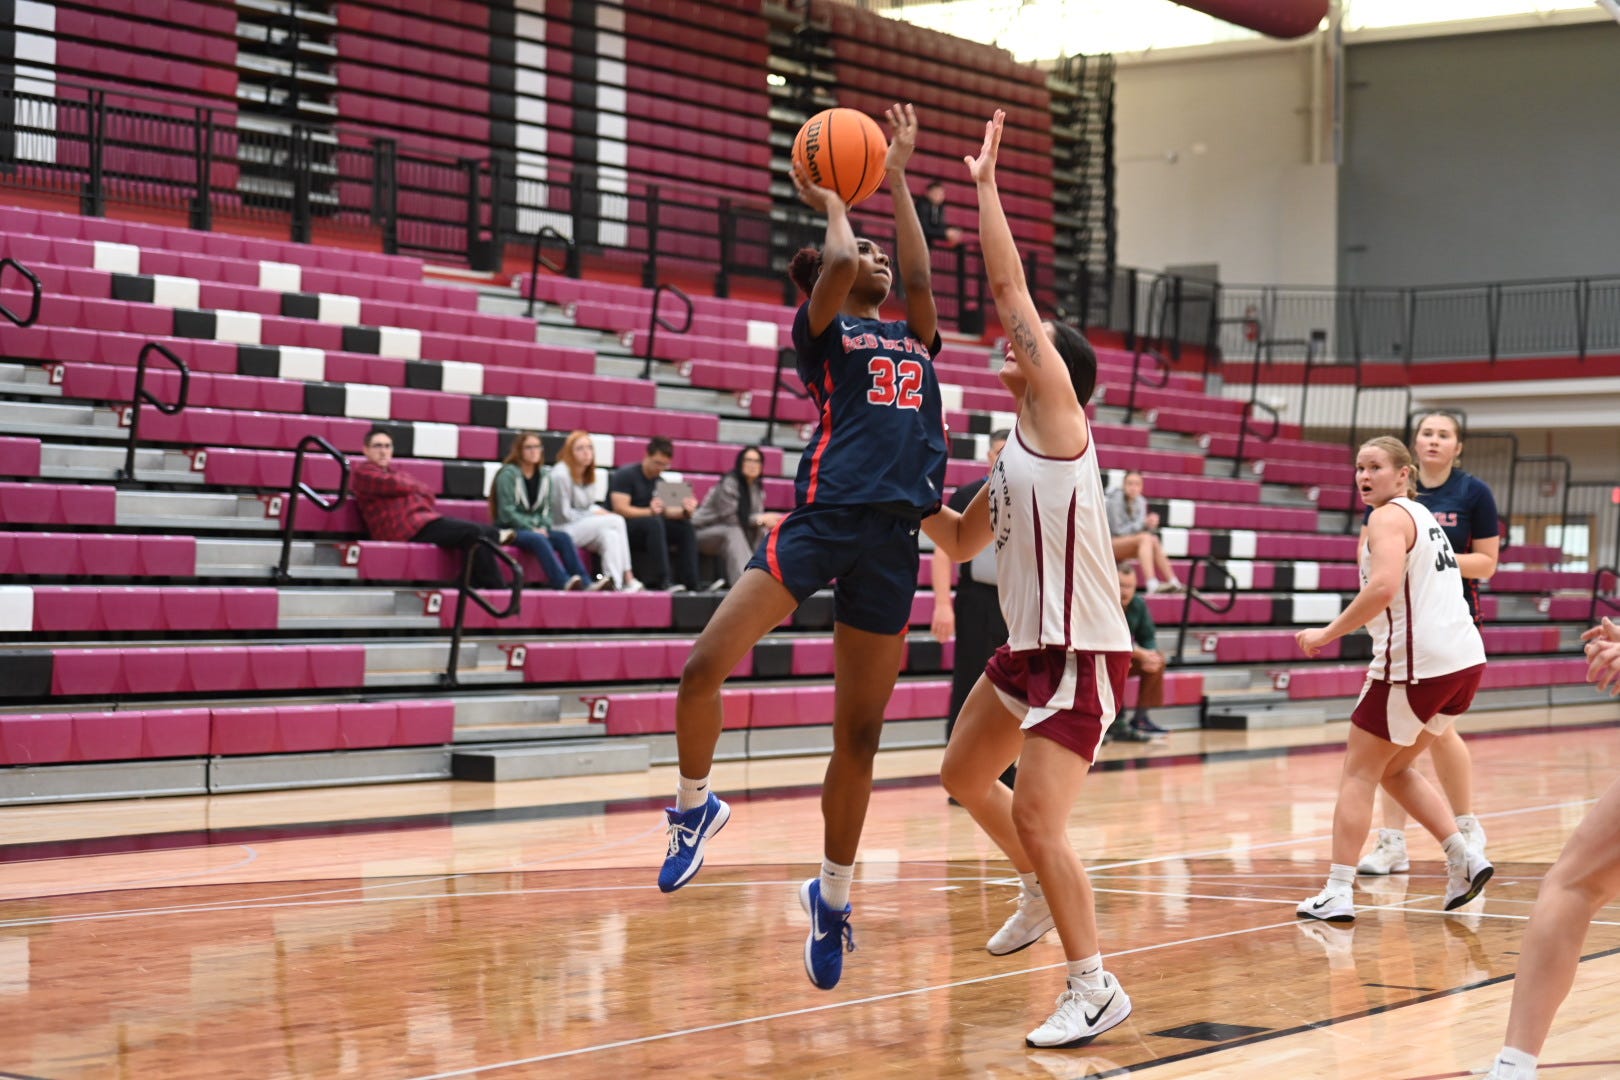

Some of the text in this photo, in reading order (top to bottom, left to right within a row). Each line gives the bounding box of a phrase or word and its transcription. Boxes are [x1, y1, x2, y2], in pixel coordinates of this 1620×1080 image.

[806, 120, 822, 184] Wilson
[842, 333, 878, 354] RED
[867, 356, 923, 412] 32
